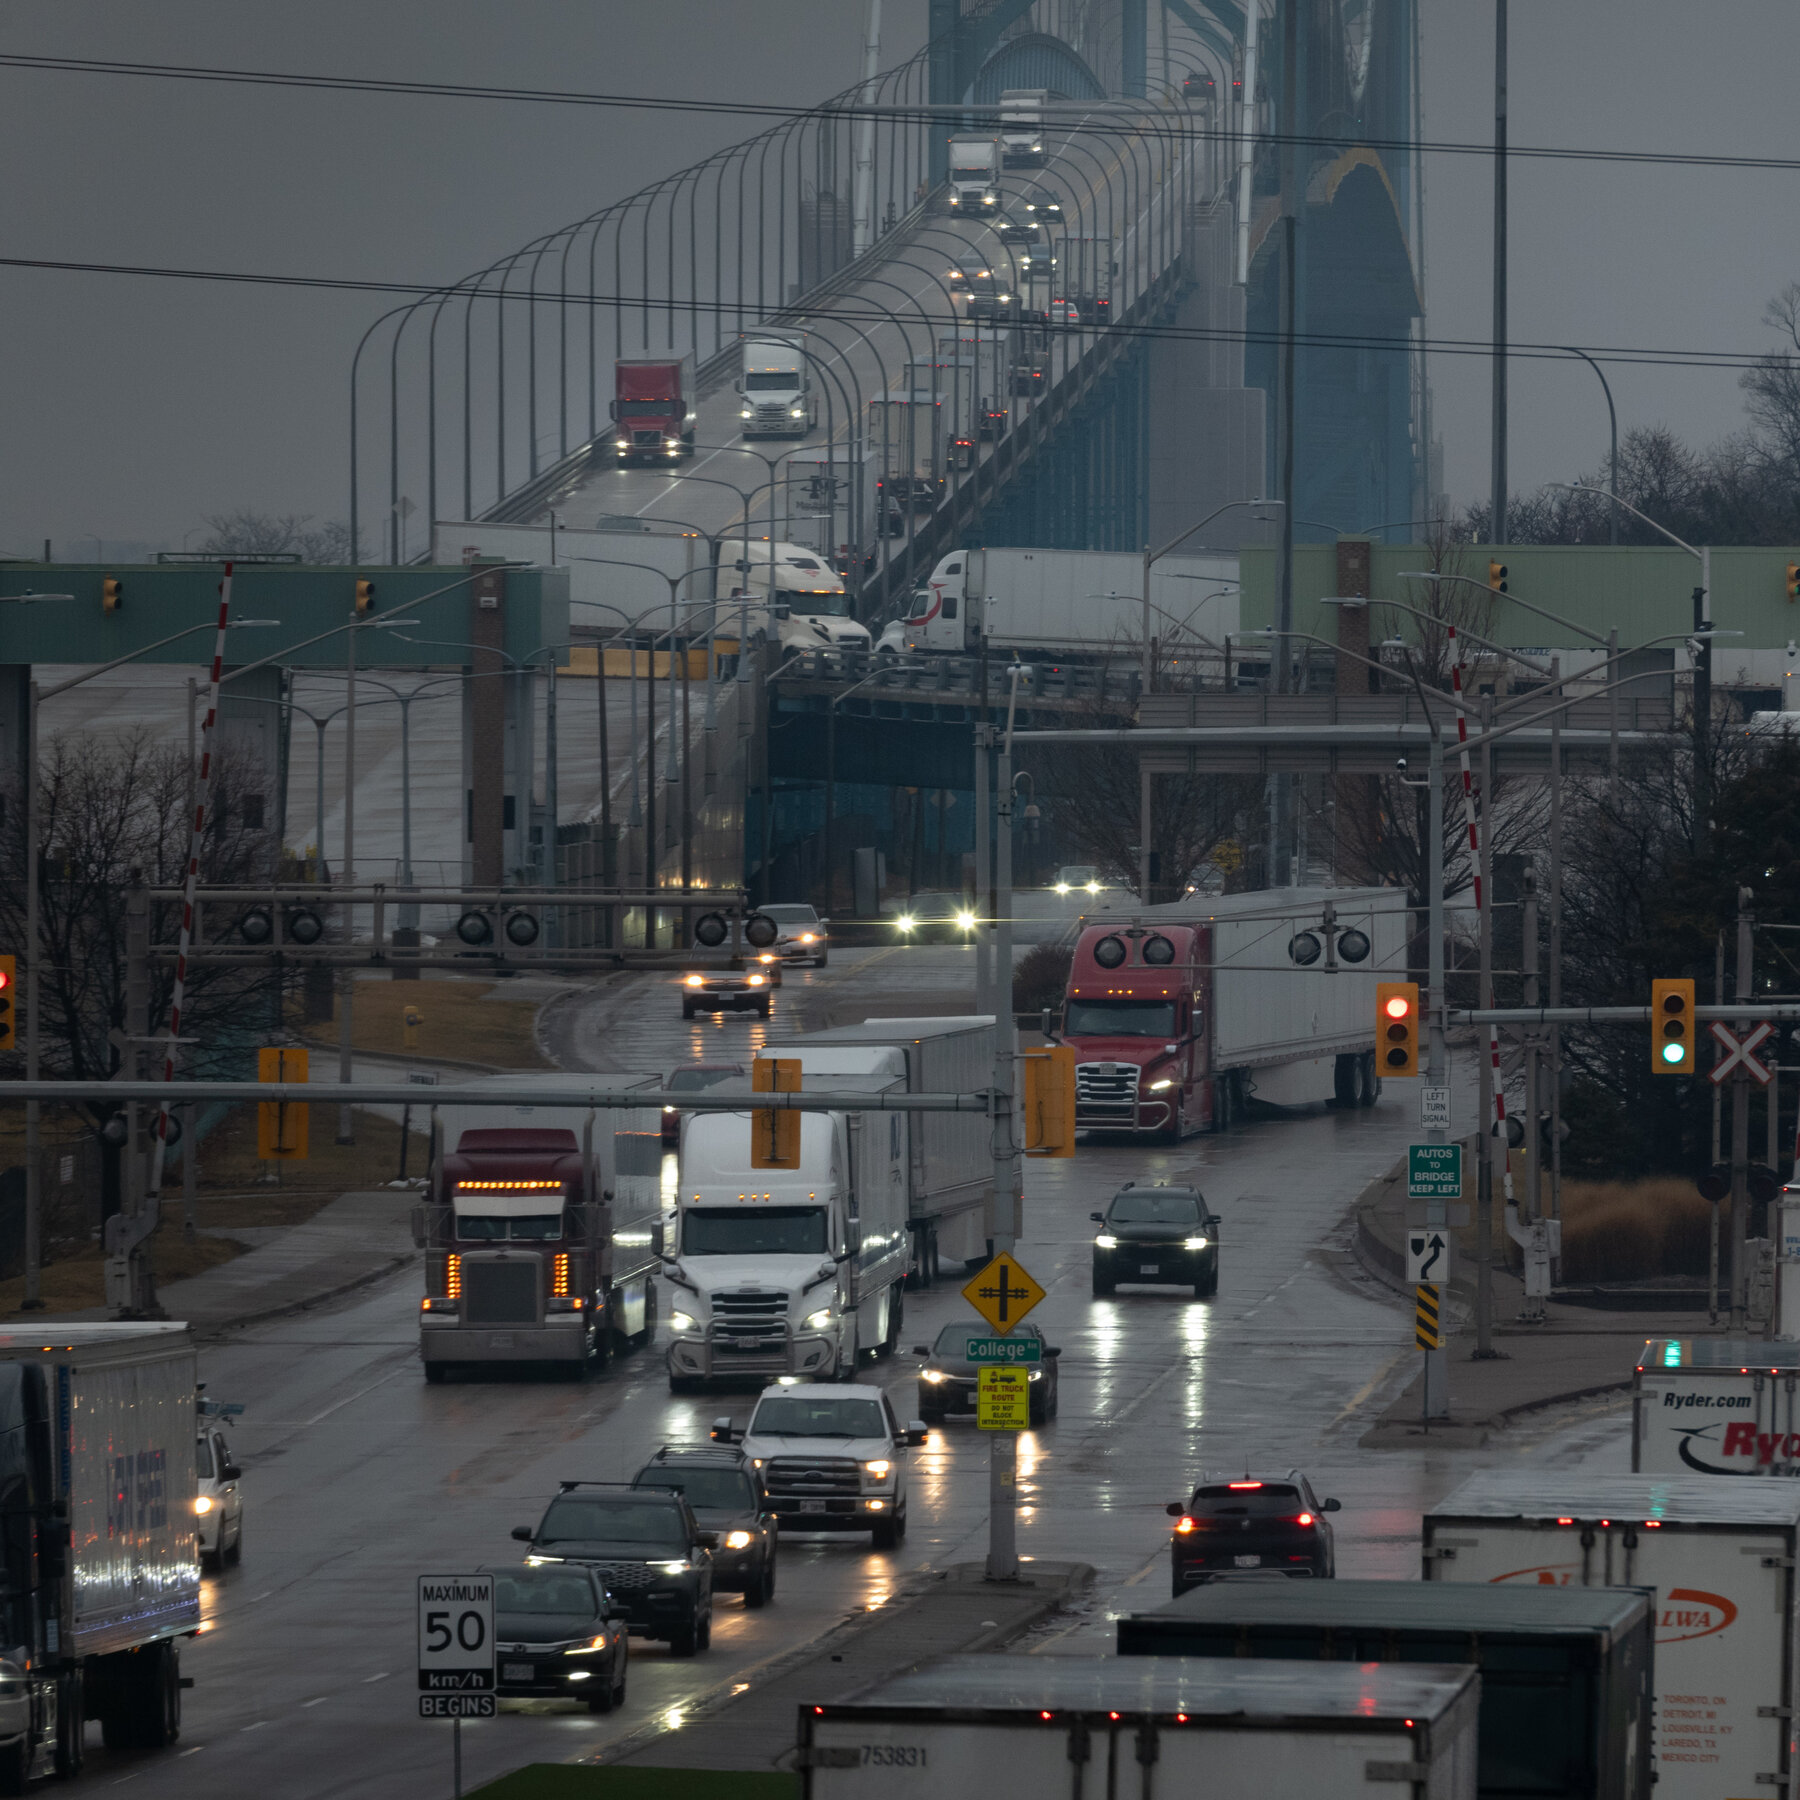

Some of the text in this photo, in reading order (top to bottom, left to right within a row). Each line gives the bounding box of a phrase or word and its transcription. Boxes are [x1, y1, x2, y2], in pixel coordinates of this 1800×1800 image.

[1426, 1092, 1445, 1101] LEFT
[1426, 1103, 1446, 1111] TURN
[1422, 1114, 1449, 1123] SIGNAL
[1416, 1149, 1453, 1159] AUTOS
[1429, 1161, 1441, 1169] TO
[1414, 1172, 1455, 1181] BRIDGE
[1410, 1184, 1460, 1193] KEEP LEFT
[967, 1341, 1025, 1360] College
[1663, 1392, 1752, 1409] Ryder.com
[422, 1585, 489, 1602] MAXIMUM
[1654, 1610, 1712, 1628] LWA
[426, 1610, 485, 1652] 50
[429, 1671, 484, 1689] km/h
[1663, 1695, 1727, 1706] TORONTO, ON
[421, 1697, 493, 1716] BEGINS
[1705, 1711, 1717, 1719] MI
[1704, 1739, 1717, 1748] TX
[861, 1745, 927, 1766] 753831
[1661, 1753, 1720, 1763] MEXICO CITY
